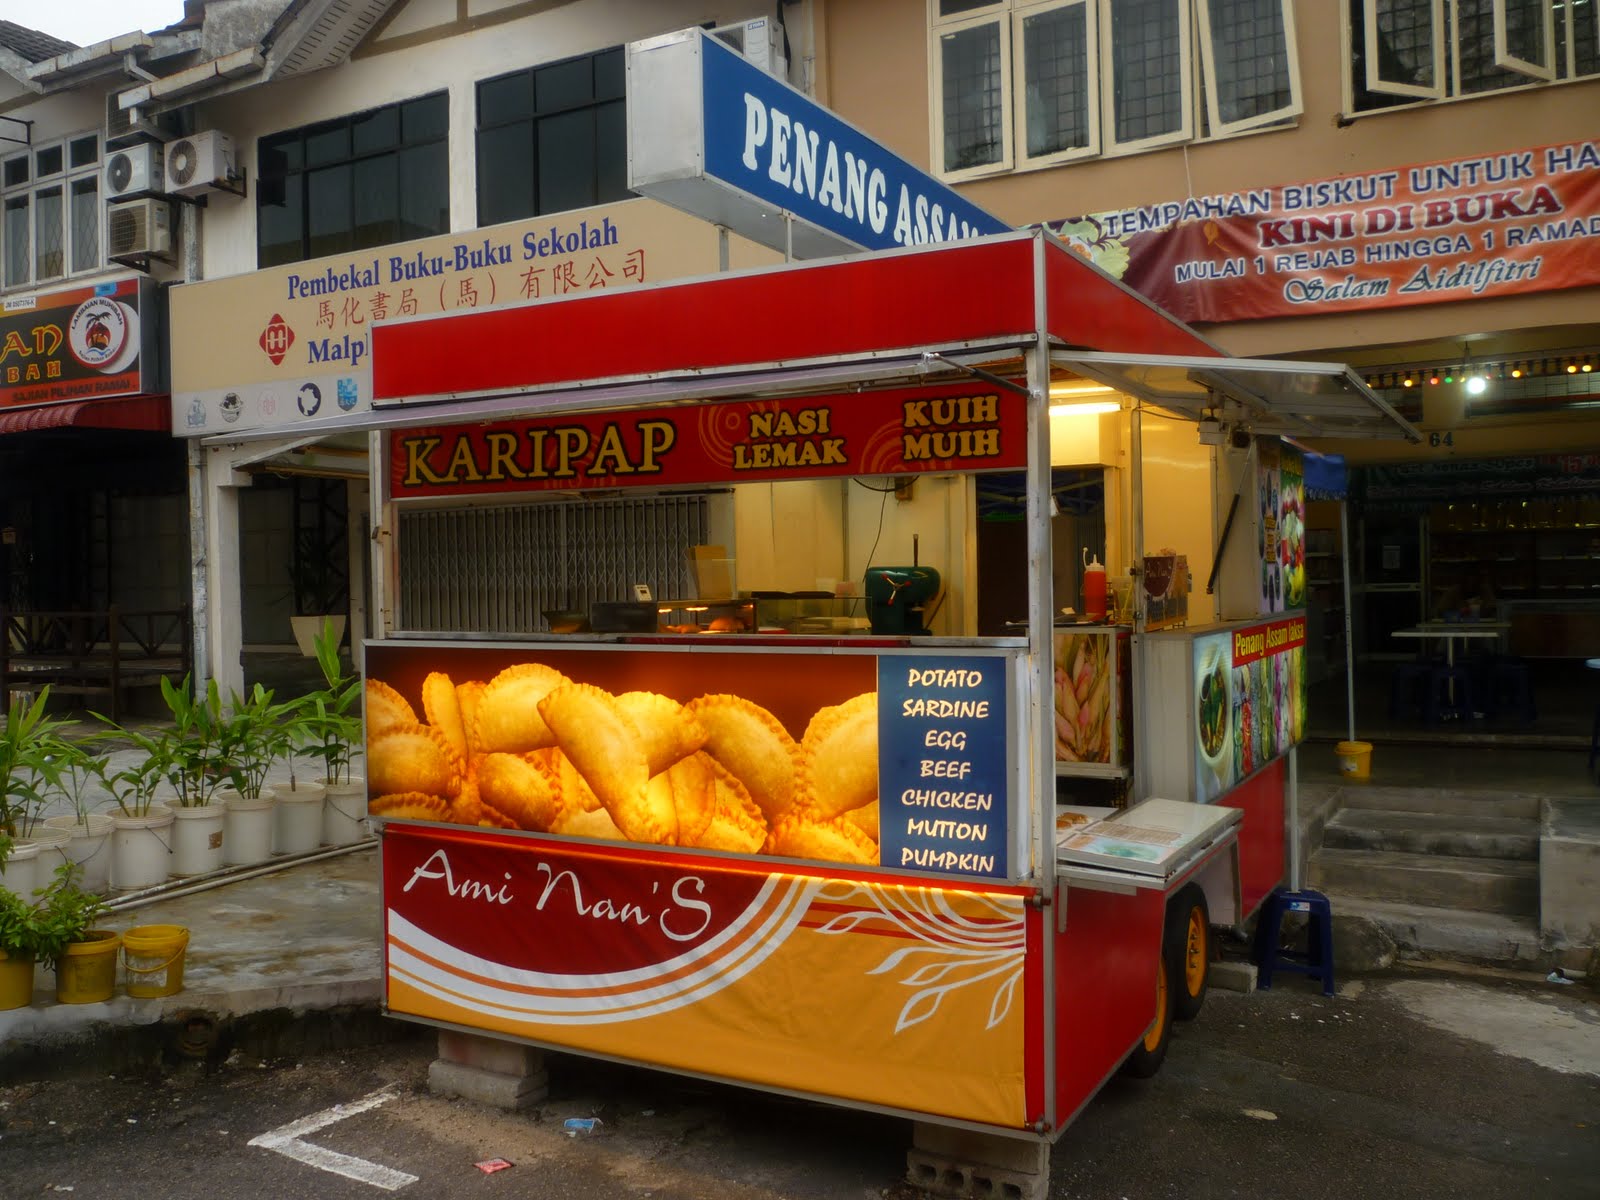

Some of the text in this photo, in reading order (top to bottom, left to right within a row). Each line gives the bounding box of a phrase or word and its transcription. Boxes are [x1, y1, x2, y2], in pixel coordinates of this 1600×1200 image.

[742, 92, 888, 234] PENANG
[1103, 142, 1600, 237] TEMPAHAN BISKUT UNTUK HA
[1258, 185, 1563, 249] KINI DI BUKA
[287, 217, 619, 300] Pembekal Buku-Buku Sekolah
[1175, 216, 1600, 284] MULAI 1 REJAB HINGGA 1 RAMAD
[1284, 256, 1542, 303] Salam Aidilfitri
[0, 360, 61, 383] BAH
[50, 382, 94, 397] PILIHAN
[750, 408, 831, 437] NASI
[903, 395, 999, 429] KUIH
[403, 422, 676, 486] KARIPAP
[734, 438, 848, 470] LEMAK
[903, 428, 1000, 460] MUIH
[1429, 432, 1453, 447] 64
[1235, 620, 1304, 659] Penang Assam laksa
[908, 668, 983, 688] POTATO
[902, 699, 989, 718] SARDINE
[924, 729, 967, 751] EGG
[920, 760, 971, 780] BEEF
[901, 789, 993, 811] CHICKEN
[907, 818, 987, 841] MUTTON
[901, 847, 995, 873] PUMPKIN
[403, 849, 712, 942] Ami Nan'S
